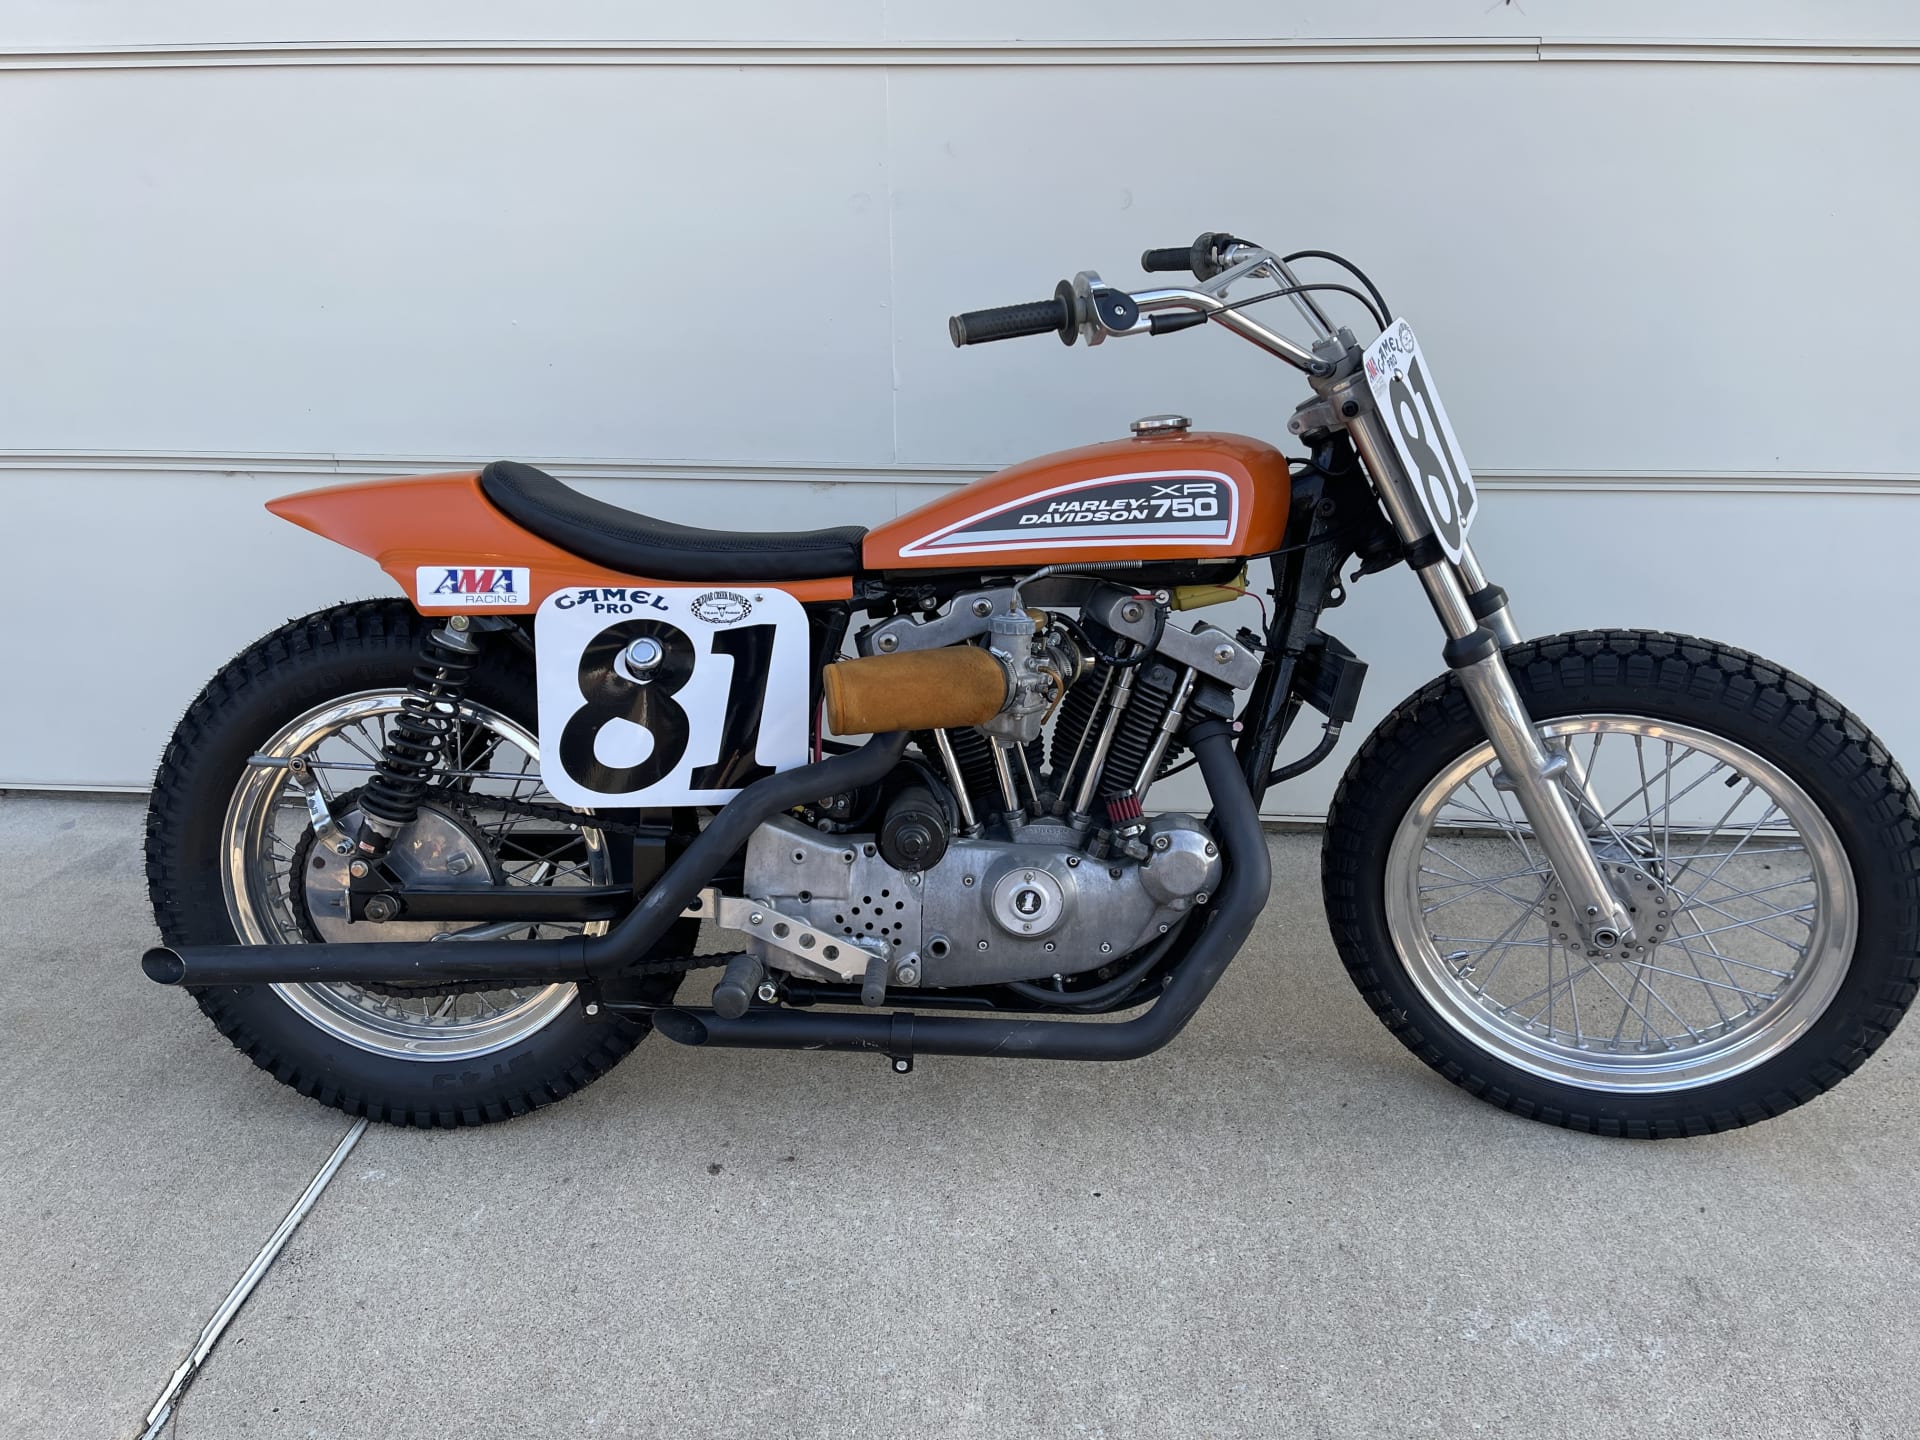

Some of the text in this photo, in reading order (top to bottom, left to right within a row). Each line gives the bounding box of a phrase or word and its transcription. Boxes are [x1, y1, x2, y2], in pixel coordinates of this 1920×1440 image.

[1377, 337, 1403, 375] CAMEL
[1388, 355, 1474, 551] 81
[1151, 483, 1217, 497] XR
[1047, 498, 1149, 513] HARLEY-
[1150, 497, 1218, 518] 750
[1018, 509, 1149, 525] DAVIDSON
[429, 568, 518, 595] AMA
[465, 594, 518, 604] RACING
[554, 588, 669, 611] CAMEL
[593, 603, 633, 615] PRO
[559, 619, 777, 794] 81
